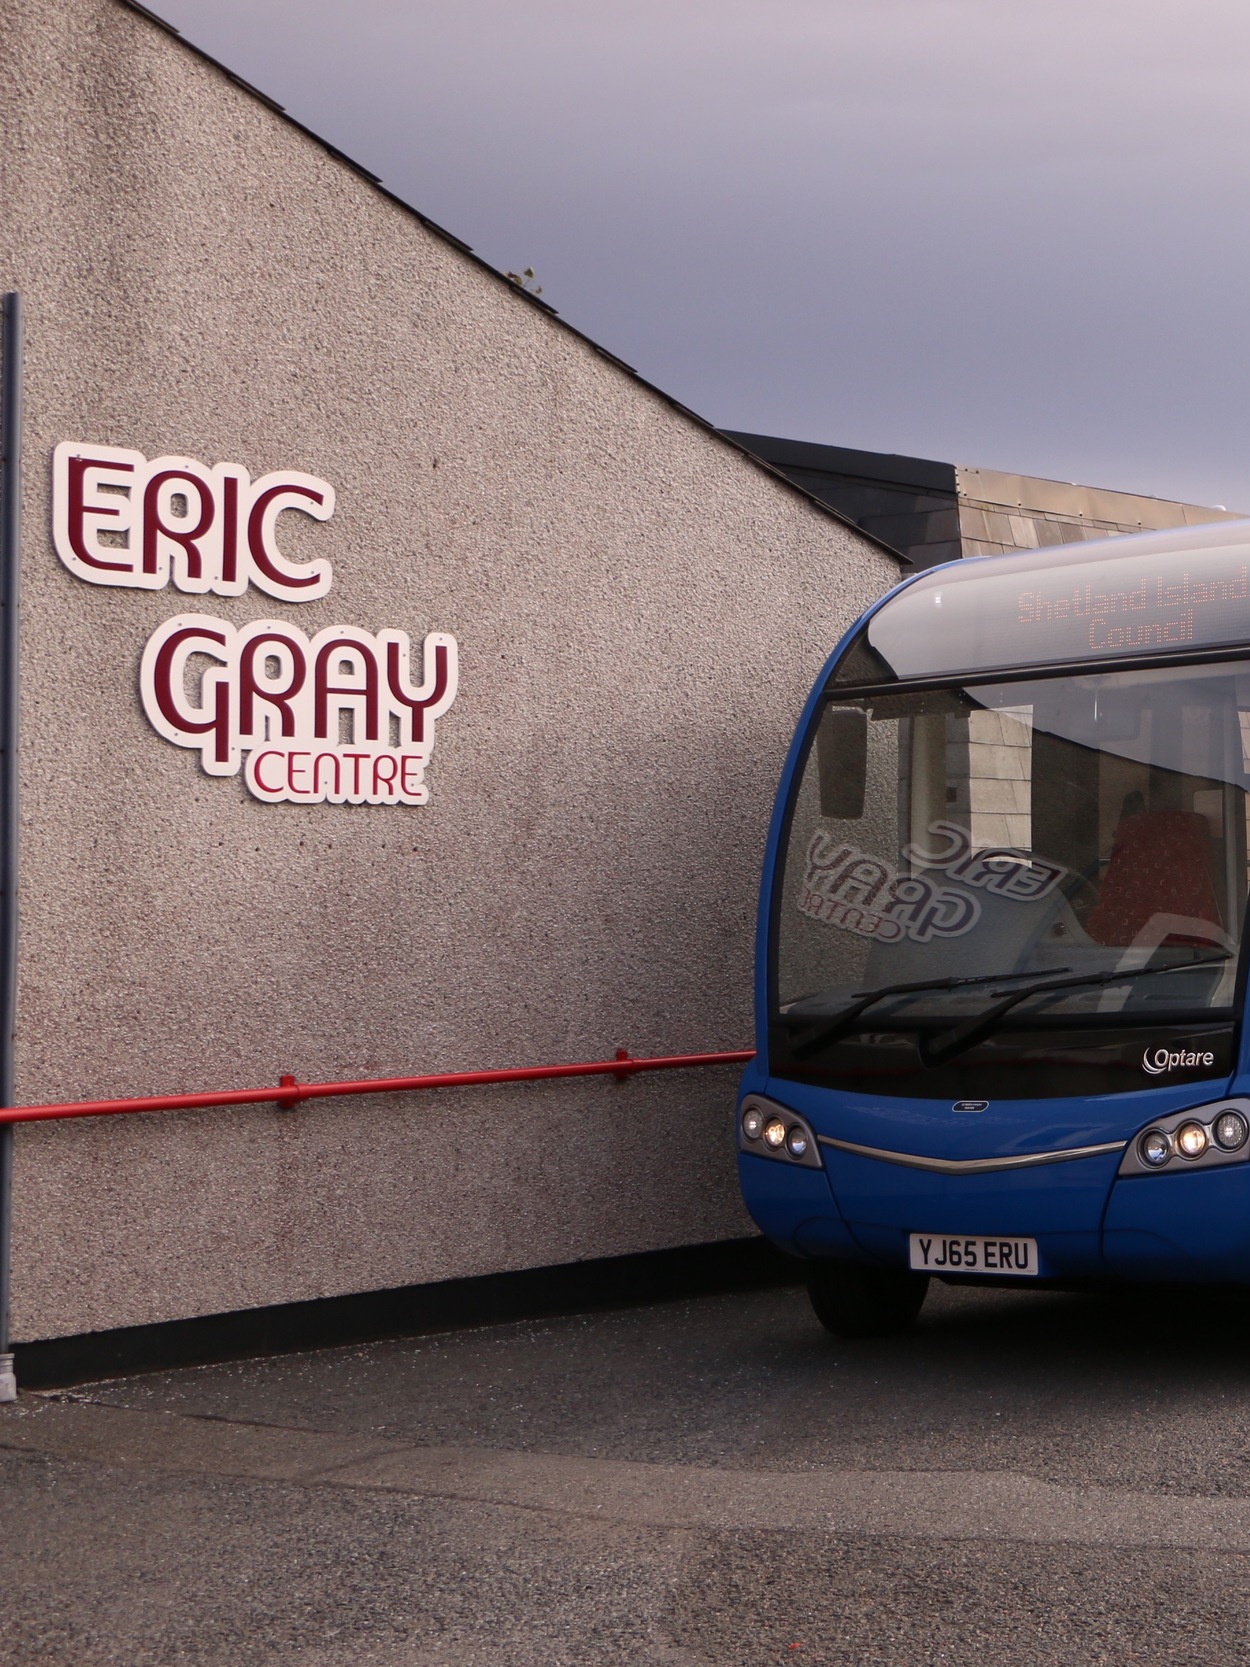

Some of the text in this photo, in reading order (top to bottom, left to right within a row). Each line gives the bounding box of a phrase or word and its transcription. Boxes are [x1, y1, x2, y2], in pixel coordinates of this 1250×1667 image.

[66, 456, 325, 589] ERIC
[1018, 577, 1147, 623] Shetland
[1089, 608, 1194, 649] Council
[153, 627, 448, 763] GRAY
[252, 750, 424, 797] CENTRE
[1154, 1048, 1215, 1072] Optare
[918, 1238, 1029, 1270] YJ65 ERU
